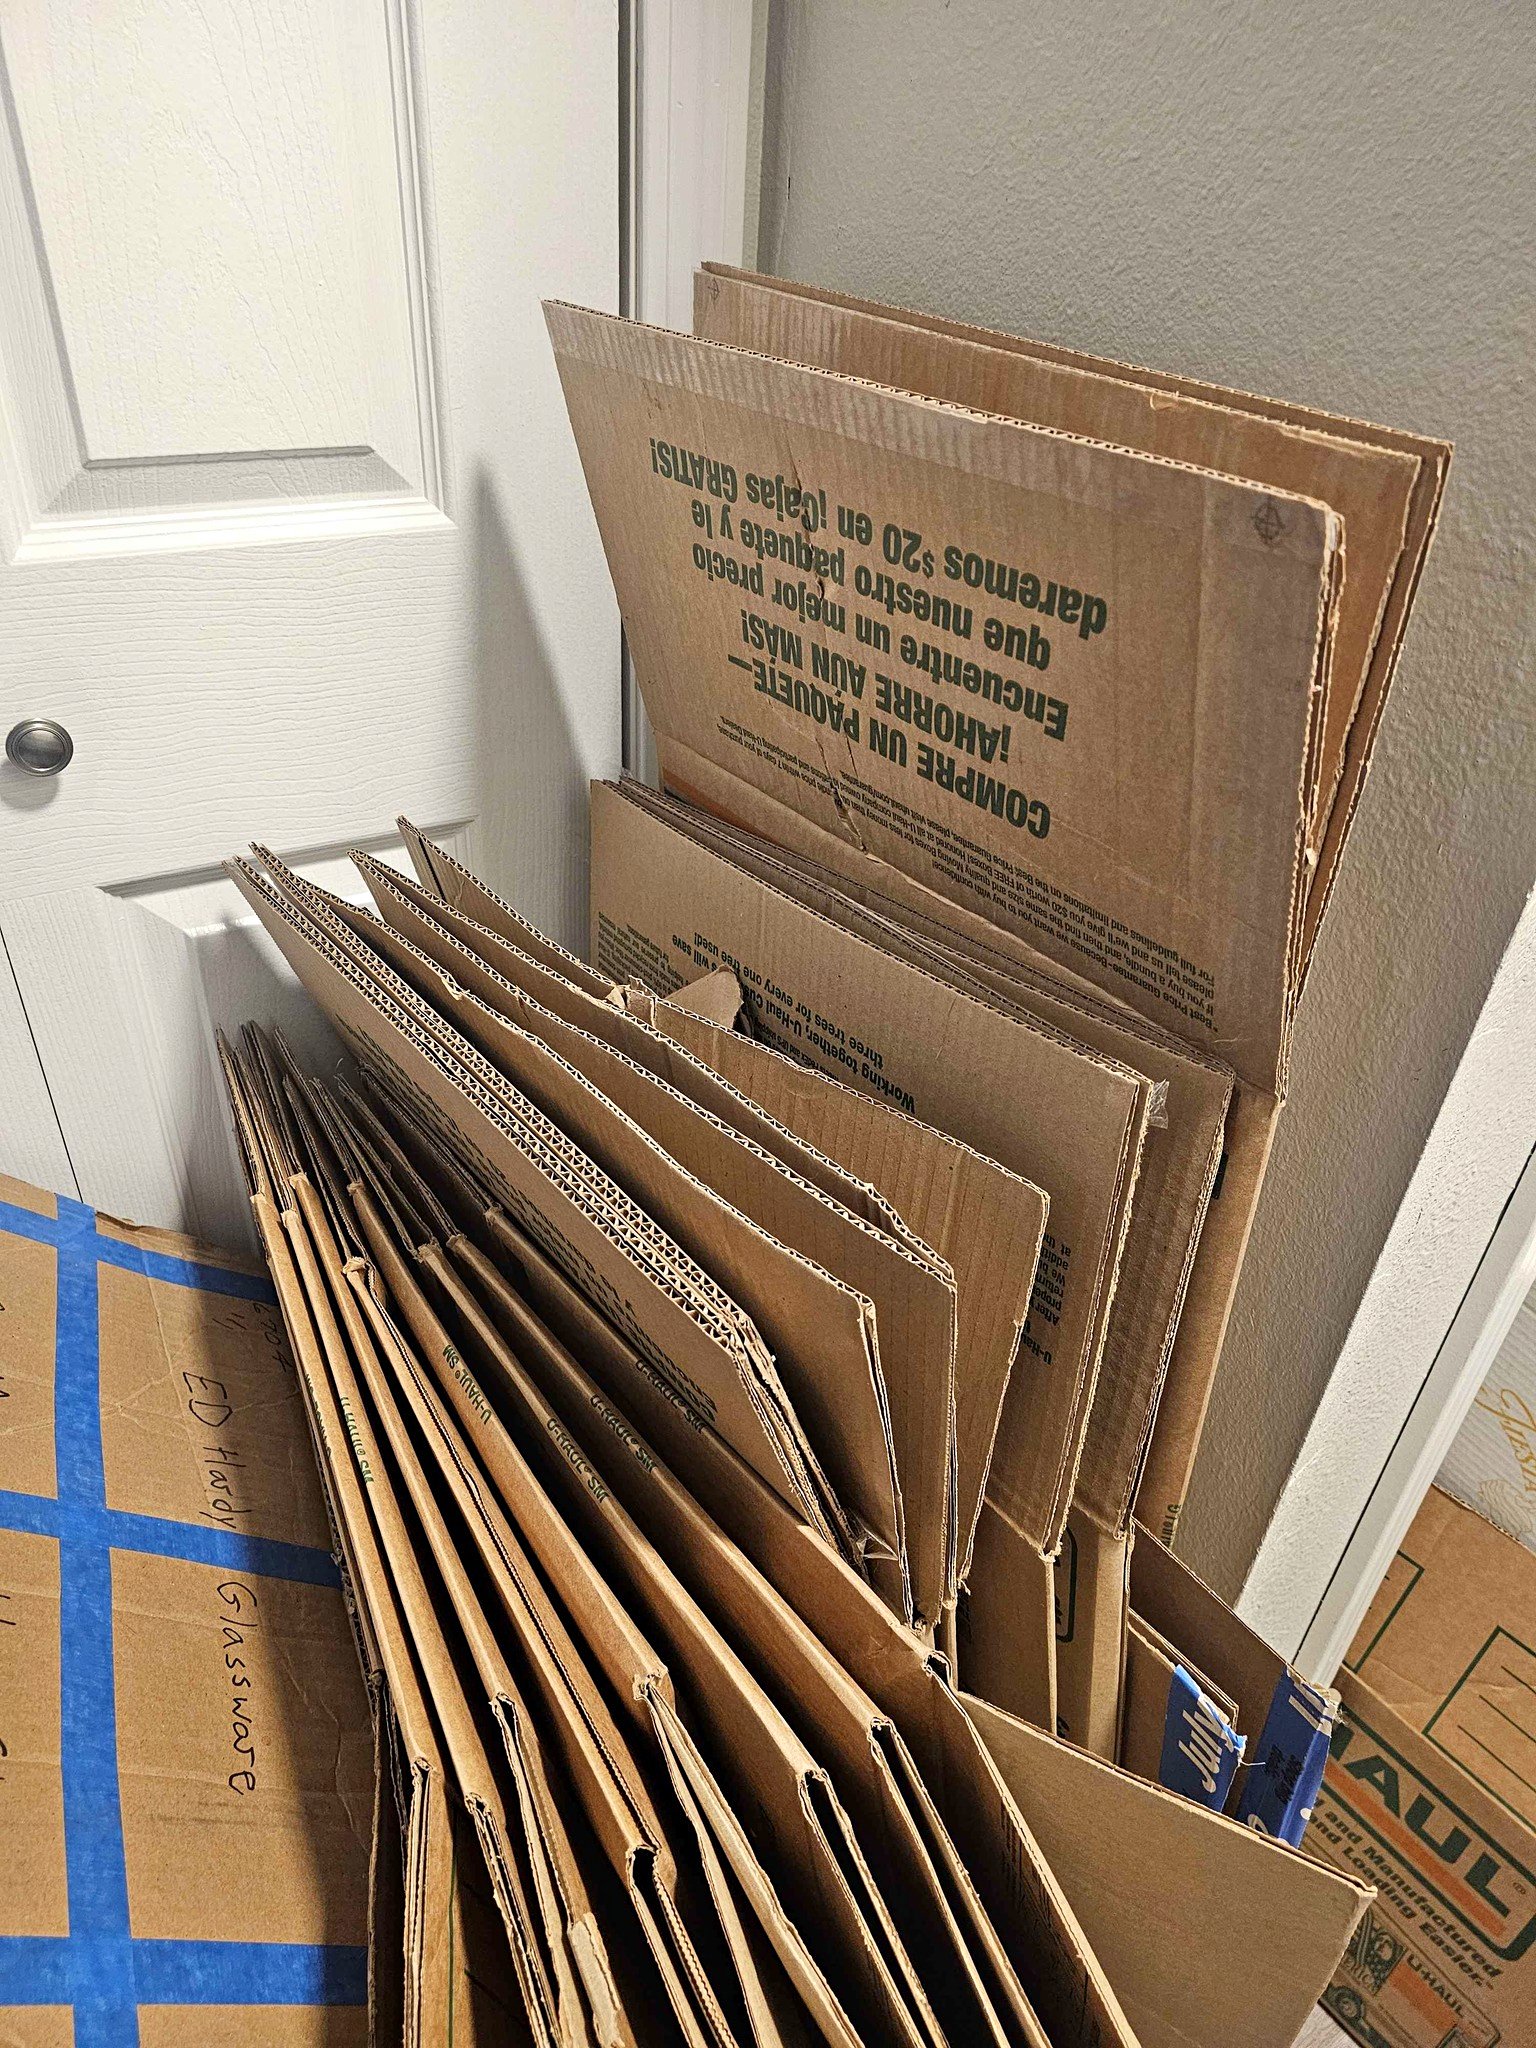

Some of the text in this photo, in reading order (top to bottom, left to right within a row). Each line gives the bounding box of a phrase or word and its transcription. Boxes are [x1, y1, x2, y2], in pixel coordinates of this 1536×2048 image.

[649, 437, 1107, 640] daremos $20 en ¡Cajas GRATIS!
[691, 499, 1050, 671] que nuestro paquete y le
[693, 543, 1069, 740] Encuentre un mejor precio
[742, 609, 1011, 762] ¡AHORRE AÚN MÁS!
[870, 719, 907, 768] UN
[917, 743, 1051, 839] COMPRE
[991, 880, 1006, 897] and
[994, 868, 1014, 888] FREE
[1034, 876, 1047, 893] the
[1050, 885, 1060, 900] on
[1025, 899, 1047, 920] same
[1049, 913, 1063, 929] the
[1051, 900, 1067, 918] $20
[1069, 907, 1085, 928] you
[1111, 918, 1127, 938] and
[672, 932, 691, 959] save
[694, 930, 718, 959] used!
[1083, 932, 1102, 951] then
[1104, 944, 1121, 962] and
[1130, 926, 1178, 966] guidelines
[1131, 944, 1148, 963] and
[694, 948, 708, 971] will
[721, 948, 740, 974] tree
[1151, 955, 1162, 971] us
[743, 963, 761, 989] one
[1167, 977, 1184, 998] buy
[1182, 970, 1214, 1000] please
[762, 973, 792, 1010] every
[1162, 991, 1187, 1015] Price
[1187, 989, 1204, 1010] you
[766, 998, 801, 1037] U-Haul
[796, 999, 810, 1023] for
[815, 1011, 844, 1046] trees
[806, 1022, 857, 1075] together,
[849, 1034, 882, 1071] three
[861, 1058, 914, 1114] Working
[1061, 1244, 1071, 1257] at
[1052, 1268, 1065, 1286] We
[1035, 1304, 1060, 1326] After
[442, 1343, 459, 1369] SM
[199, 1446, 252, 1530] Hardy
[586, 1475, 610, 1503] SM
[216, 1581, 258, 1796] Glassware
[1324, 1809, 1503, 1978] and Manufactured
[1342, 1845, 1417, 1920] Loading
[1406, 1953, 1466, 2019] U-HAUL
